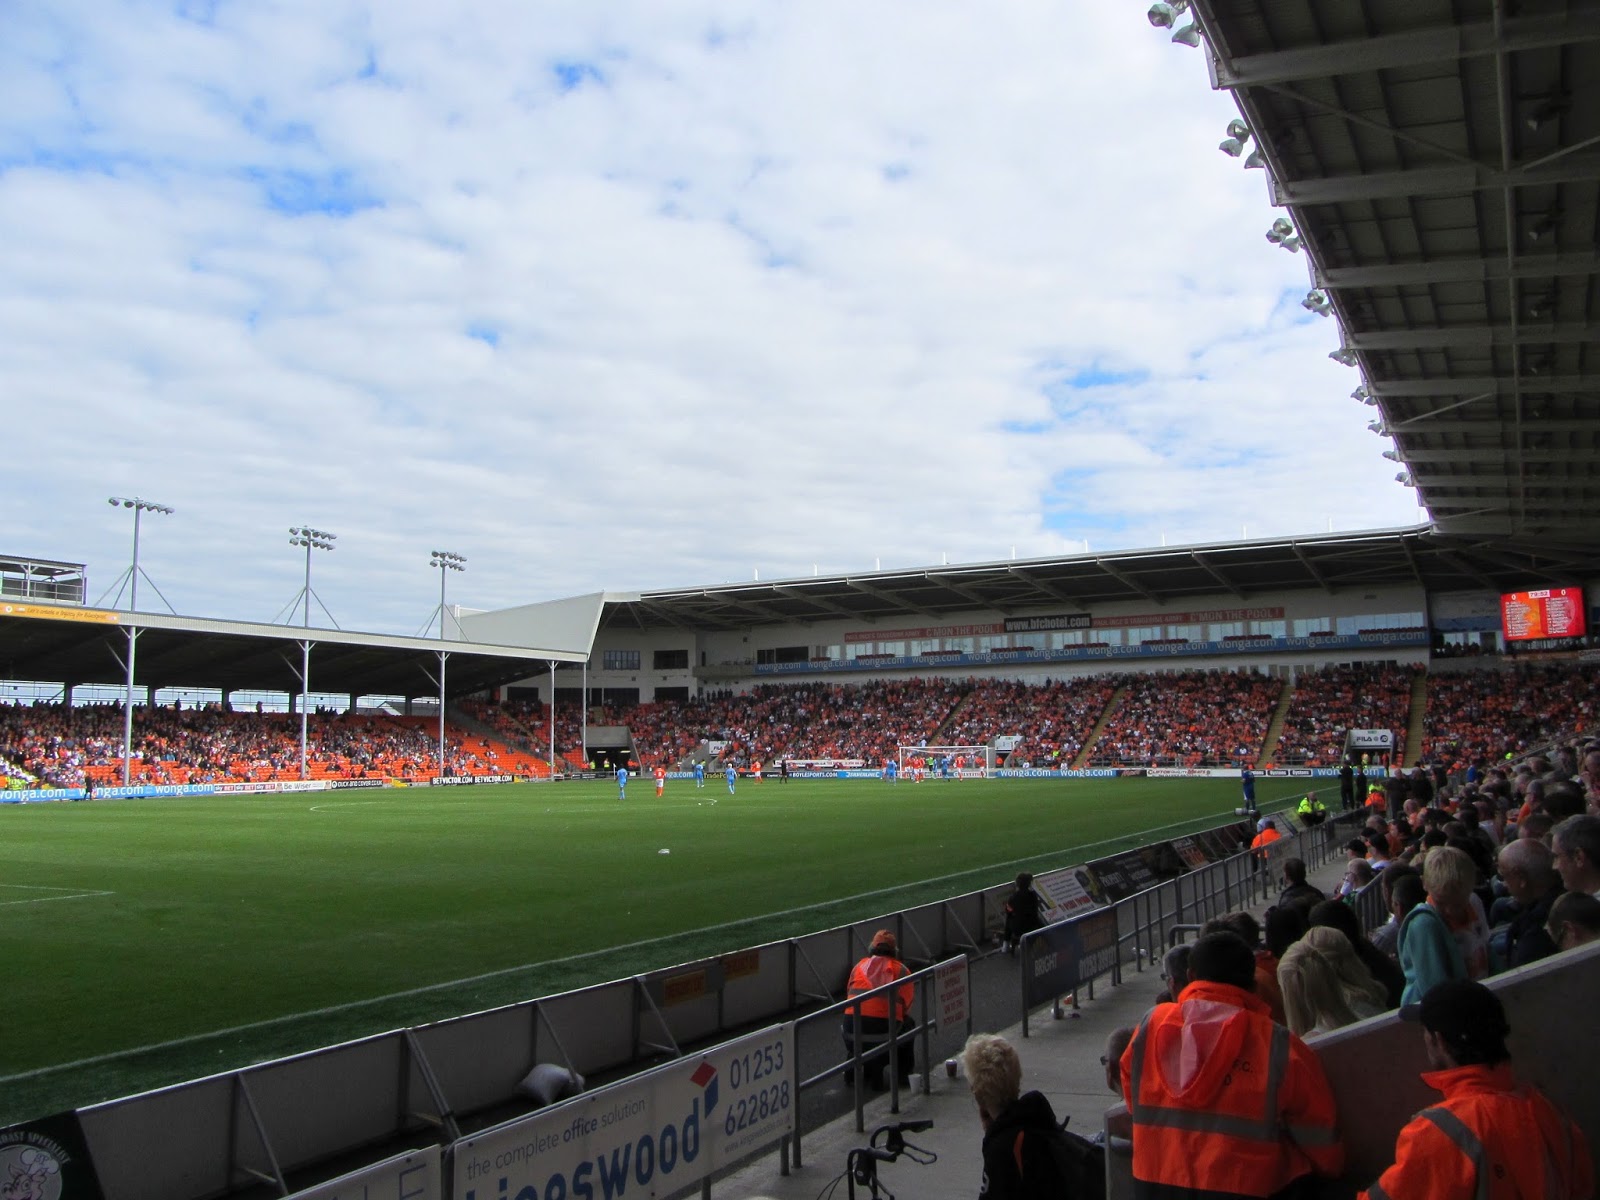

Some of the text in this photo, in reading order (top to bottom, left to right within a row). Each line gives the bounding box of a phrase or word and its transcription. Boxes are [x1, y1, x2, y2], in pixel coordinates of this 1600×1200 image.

[1006, 616, 1090, 631] www.bfchotel.com
[1286, 634, 1349, 647] wonga.com
[1358, 630, 1425, 644] wonga.com
[1150, 642, 1207, 654] wonga.com
[1217, 638, 1276, 650] wonga.com
[968, 651, 1018, 662] wonga.com
[1026, 648, 1079, 659] wonga.com
[1087, 645, 1142, 657] wonga.com
[858, 657, 905, 668] wonga.com
[912, 654, 960, 665] wonga.com
[758, 662, 801, 673] wonga.com
[807, 660, 852, 671] wonga.com
[474, 775, 513, 783] BETVICTOR.COM
[1000, 769, 1051, 778] wonga.com
[1060, 769, 1113, 778] wonga.com
[284, 782, 312, 790] Be Wiser
[432, 776, 473, 785] BETVICTOR.COM
[79, 785, 144, 799] wnga.com
[155, 783, 213, 796] wonga.com
[730, 1041, 785, 1090] 01253
[725, 1079, 790, 1136] 622828
[467, 1098, 646, 1181] the complete office solution
